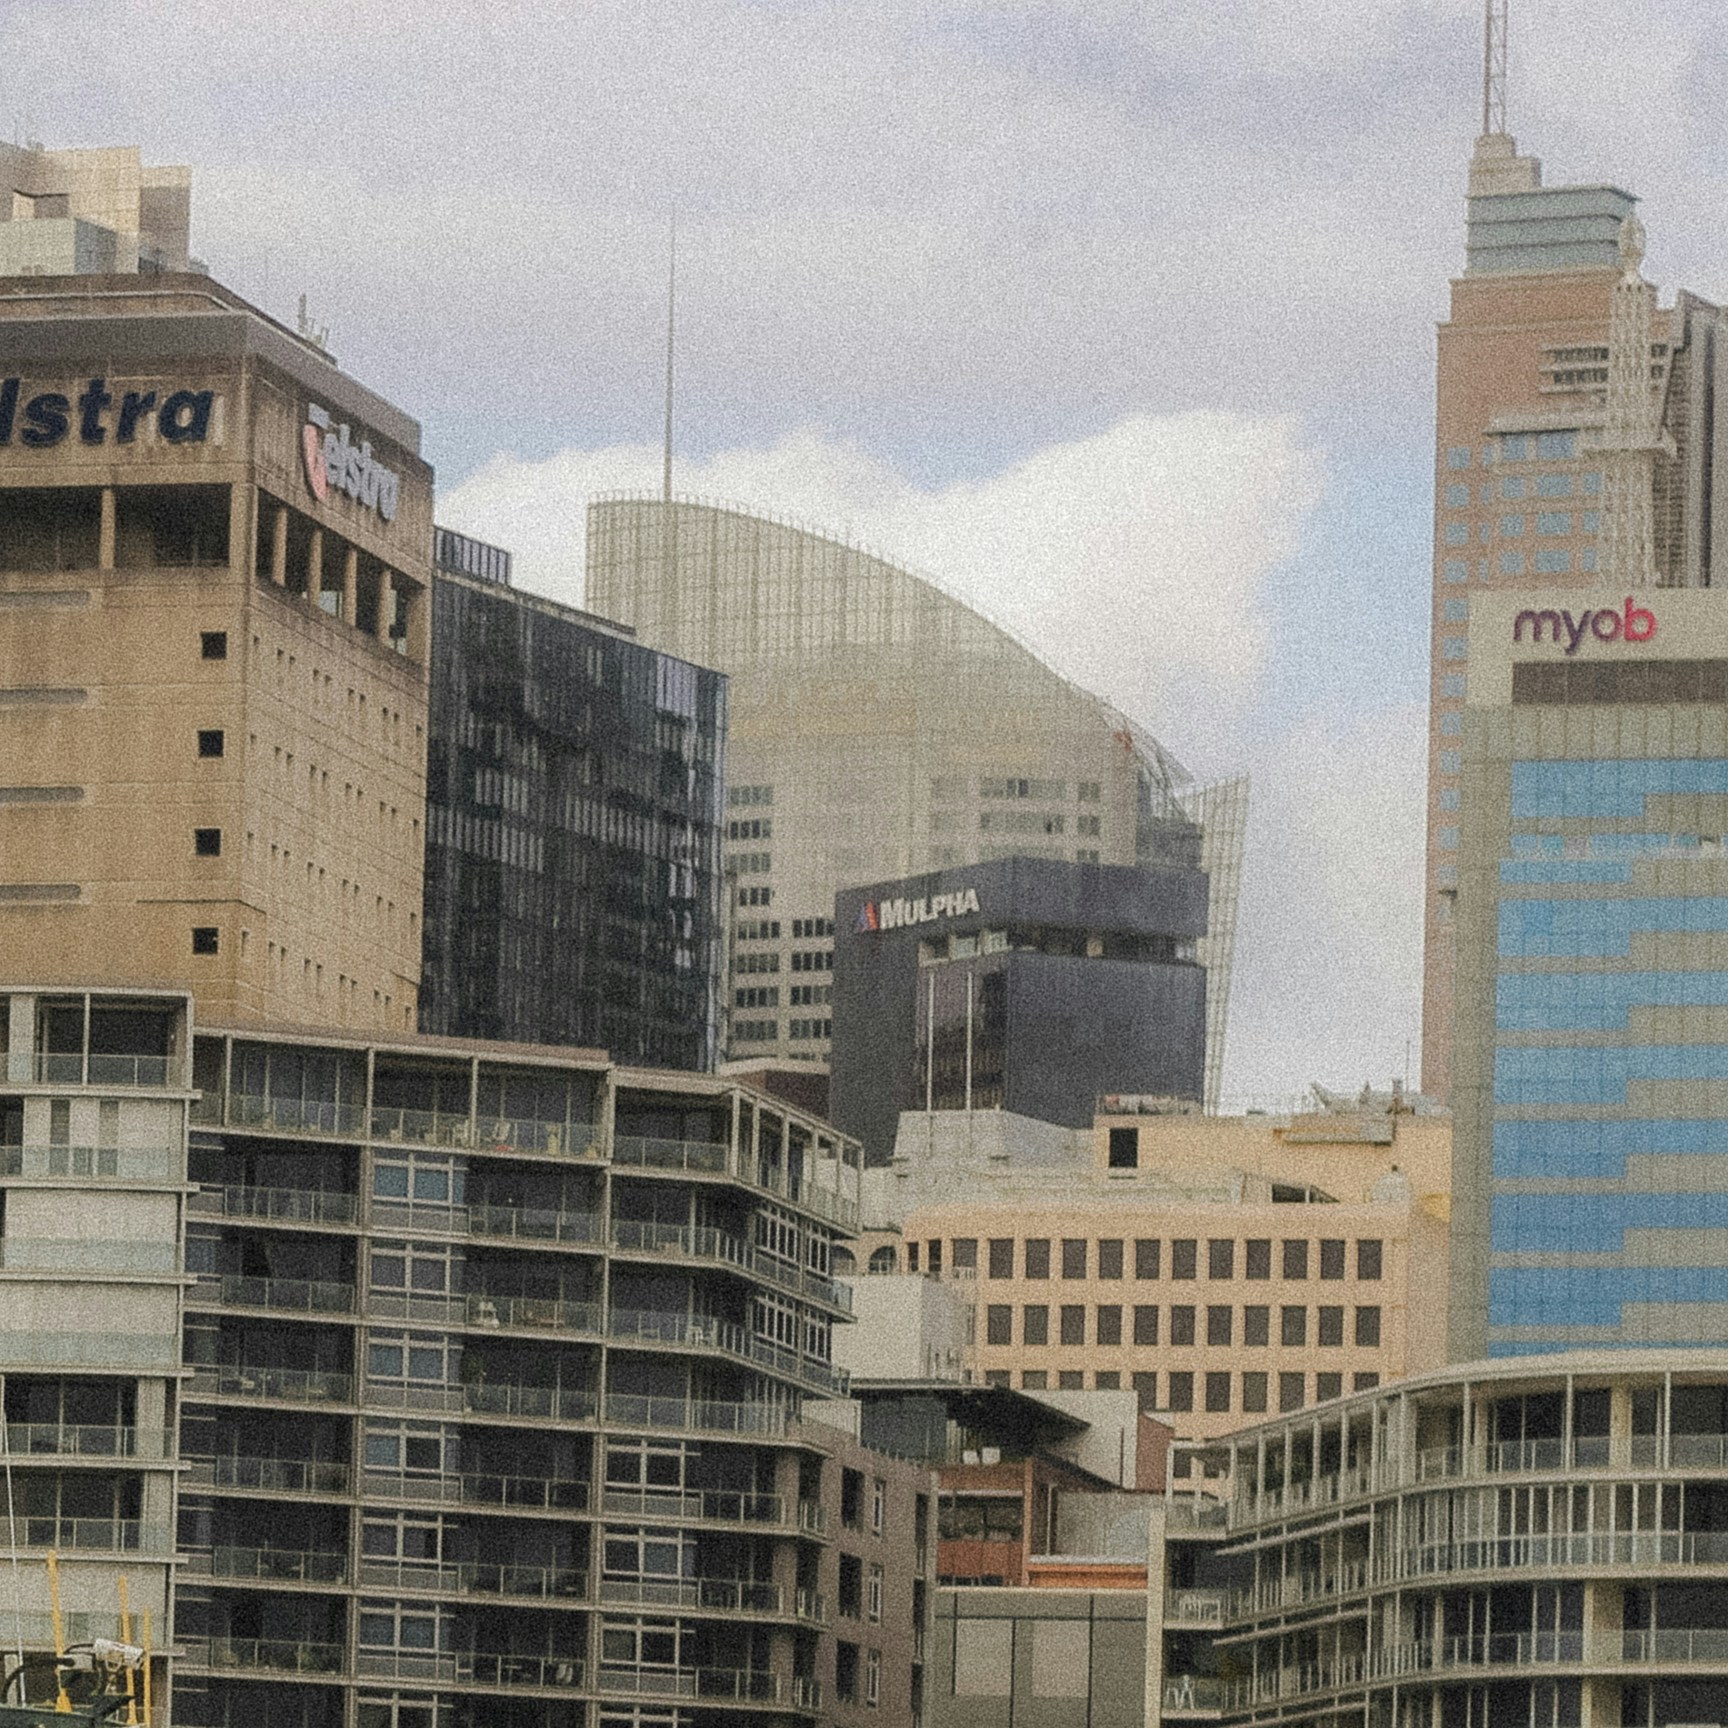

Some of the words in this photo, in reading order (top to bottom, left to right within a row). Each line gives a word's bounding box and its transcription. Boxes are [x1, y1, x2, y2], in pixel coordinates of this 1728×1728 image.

[303, 403, 399, 521] Telstra
[1513, 596, 1657, 656] myob
[880, 888, 980, 929] MULPHA
